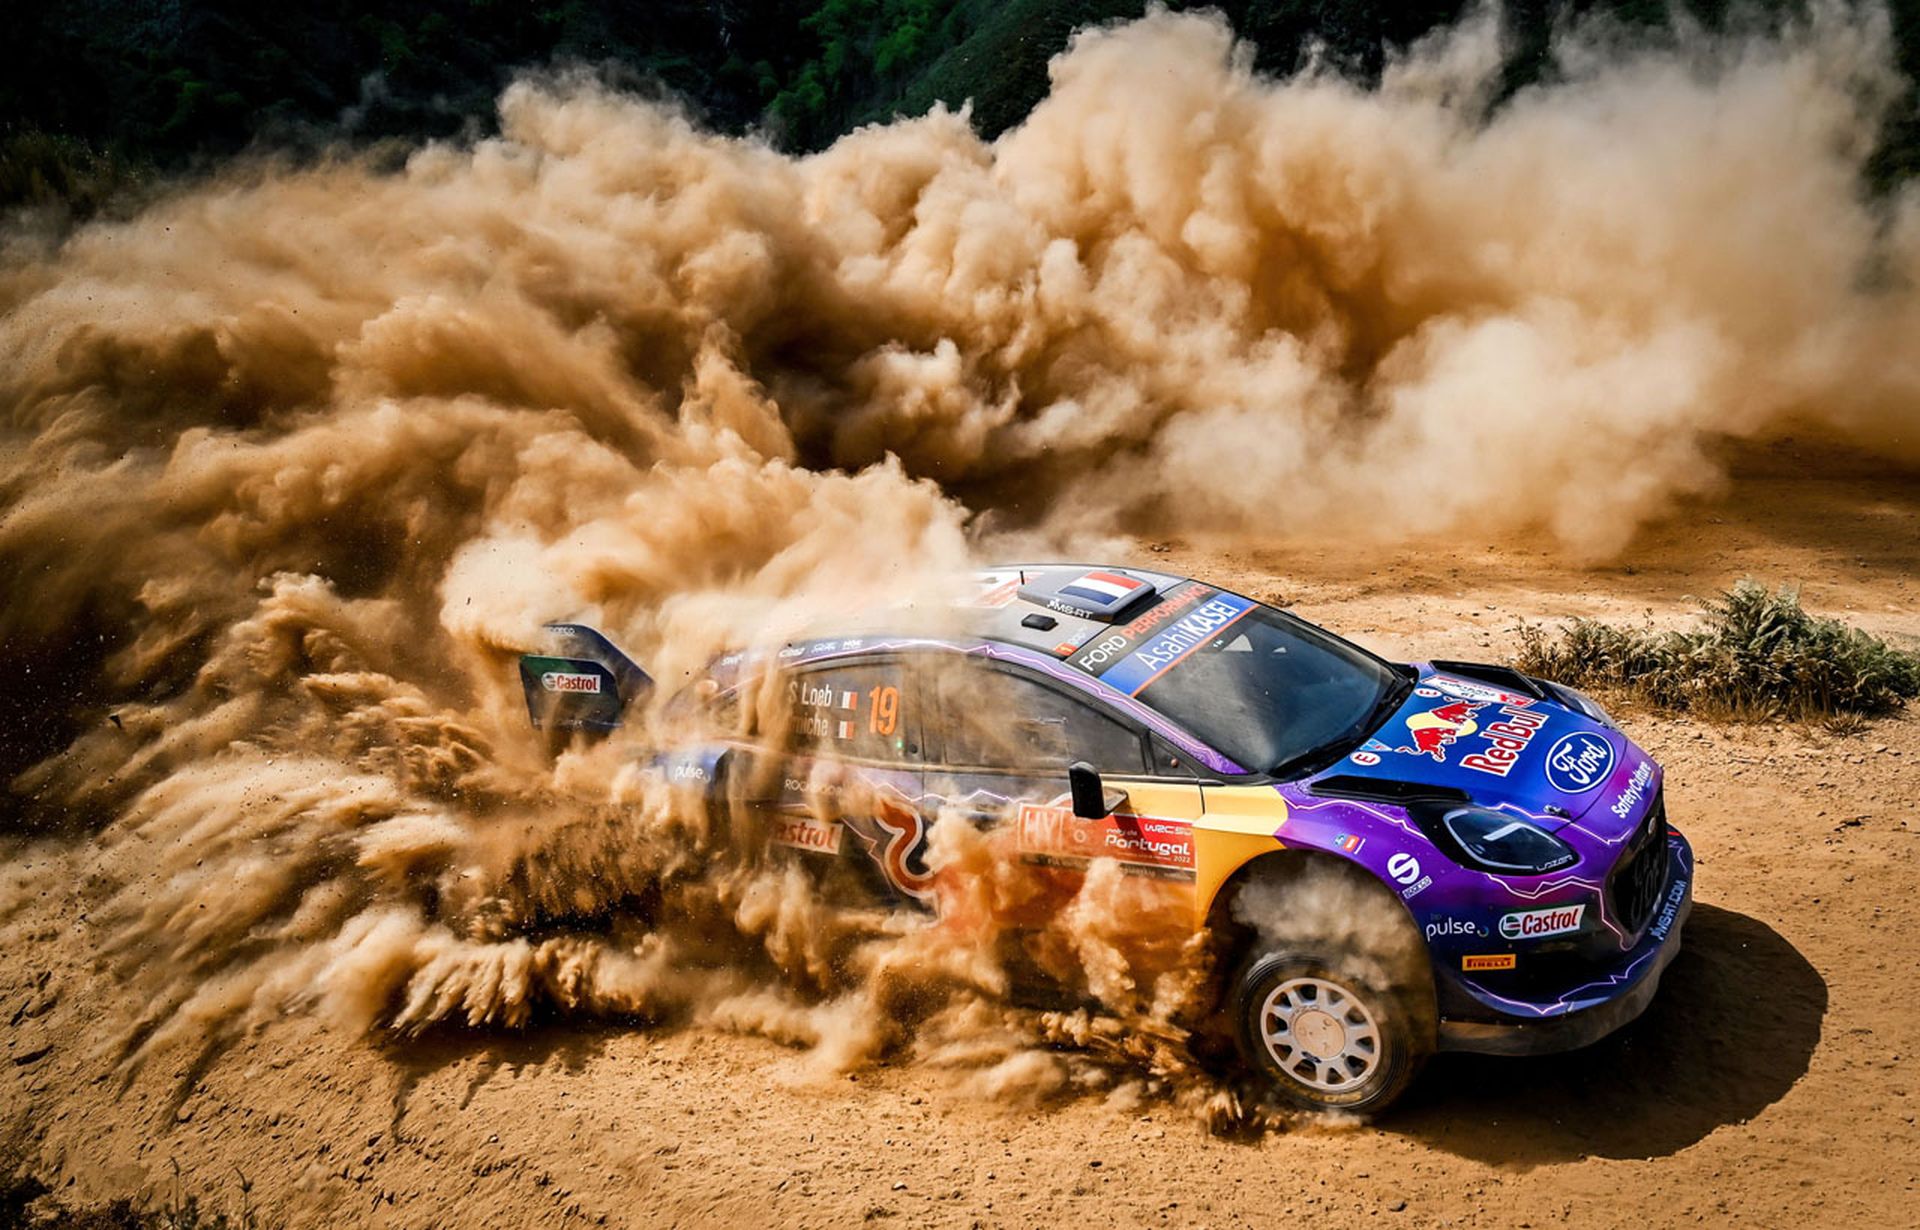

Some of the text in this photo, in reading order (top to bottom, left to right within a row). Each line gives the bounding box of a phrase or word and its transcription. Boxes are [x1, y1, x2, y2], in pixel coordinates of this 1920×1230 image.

[1079, 635, 1127, 671] FORD
[1122, 584, 1212, 641] PERFORMANCE
[556, 674, 598, 692] Castrol
[801, 682, 832, 707] Loeb
[868, 685, 898, 736] 19
[1553, 737, 1609, 784] Ford
[774, 820, 836, 850] astrol
[1105, 834, 1190, 857] Portugal
[1173, 856, 1190, 864] 2022
[1426, 916, 1476, 942] pulse
[1521, 907, 1582, 936] Castrol
[1466, 957, 1512, 968] PIRELLI
